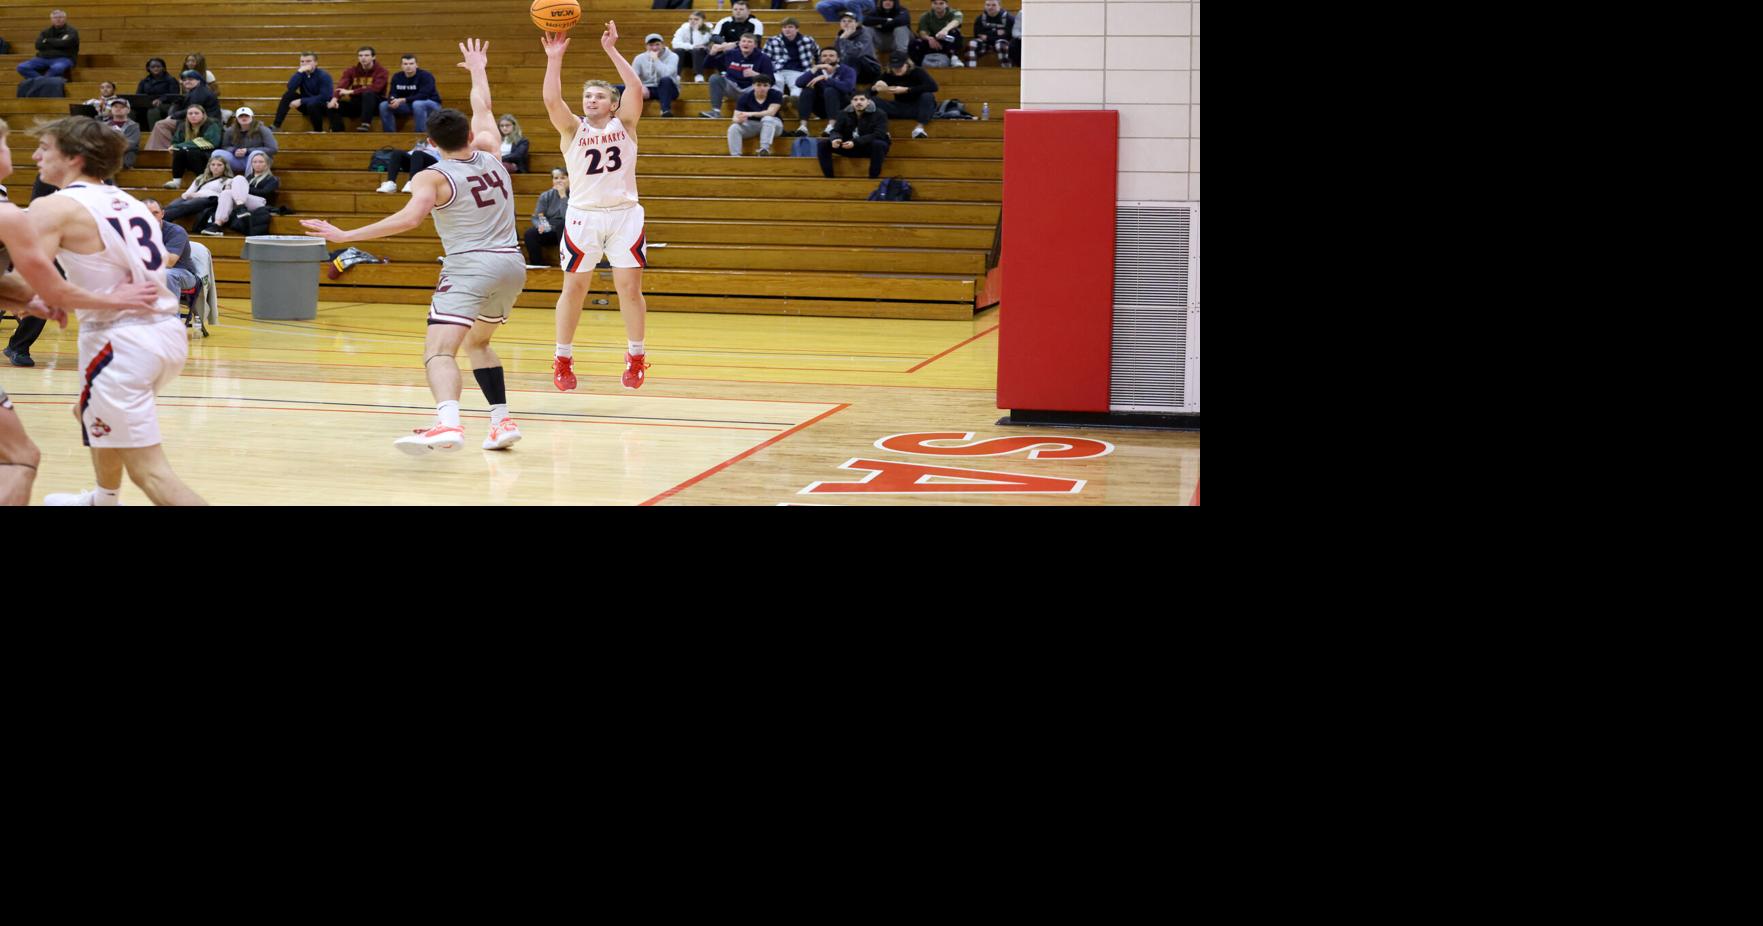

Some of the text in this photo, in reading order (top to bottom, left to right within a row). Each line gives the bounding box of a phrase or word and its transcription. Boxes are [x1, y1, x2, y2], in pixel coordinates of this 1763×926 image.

[578, 136, 599, 146] SAINT
[585, 146, 622, 175] 23
[466, 170, 508, 208] 24
[776, 432, 1115, 506] SA
